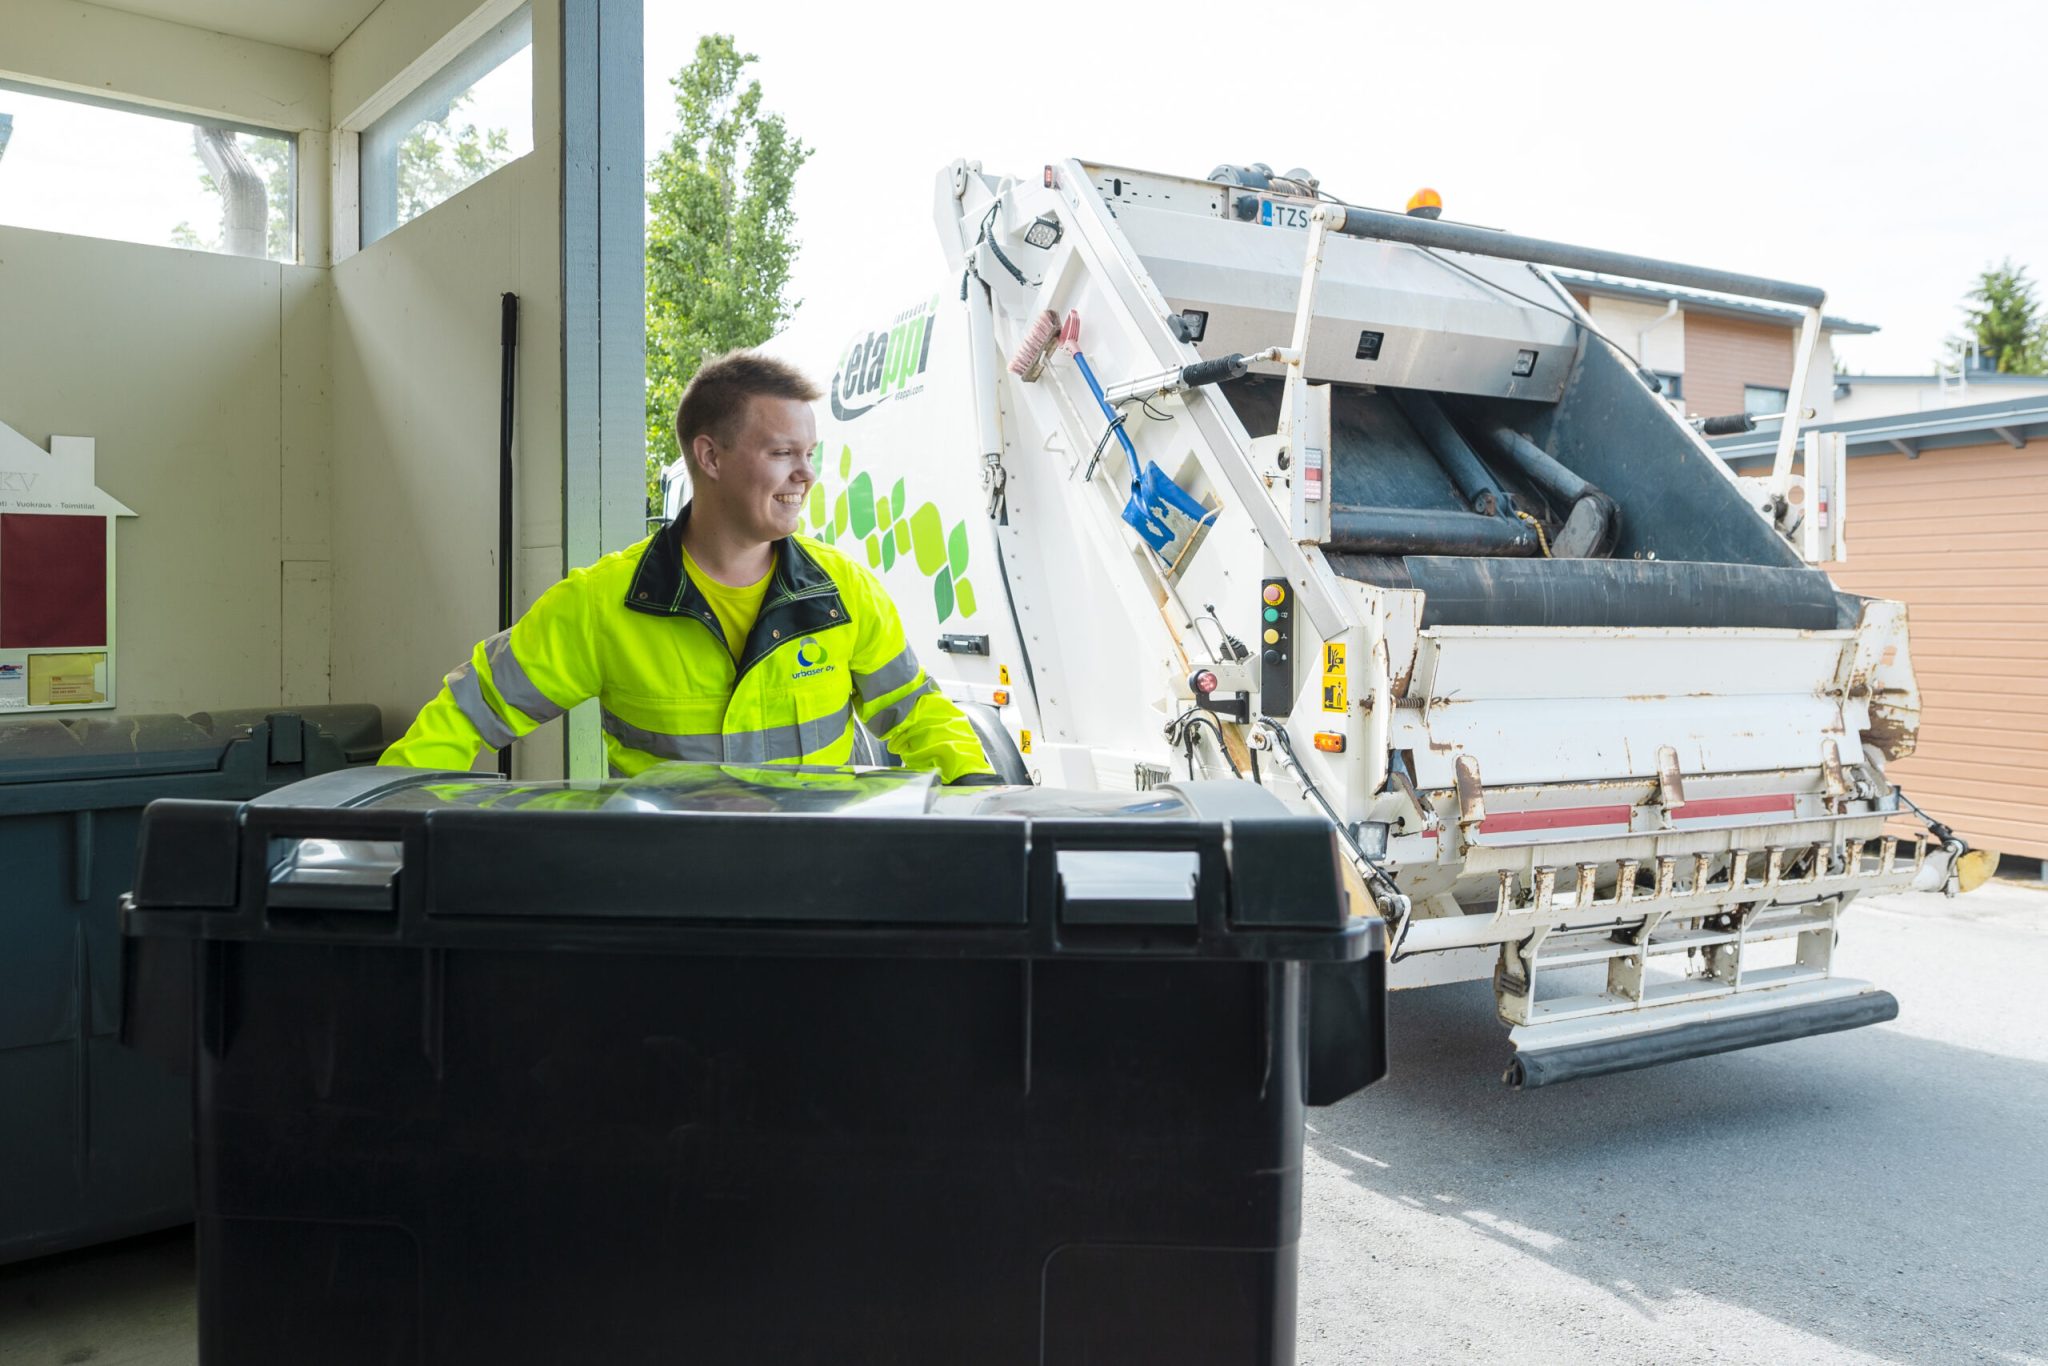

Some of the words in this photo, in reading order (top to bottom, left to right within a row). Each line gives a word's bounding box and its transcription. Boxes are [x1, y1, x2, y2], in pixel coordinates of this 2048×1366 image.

[843, 294, 938, 399] etappi
[60, 502, 95, 510] Toimitilat
[792, 668, 824, 679] urbaser
